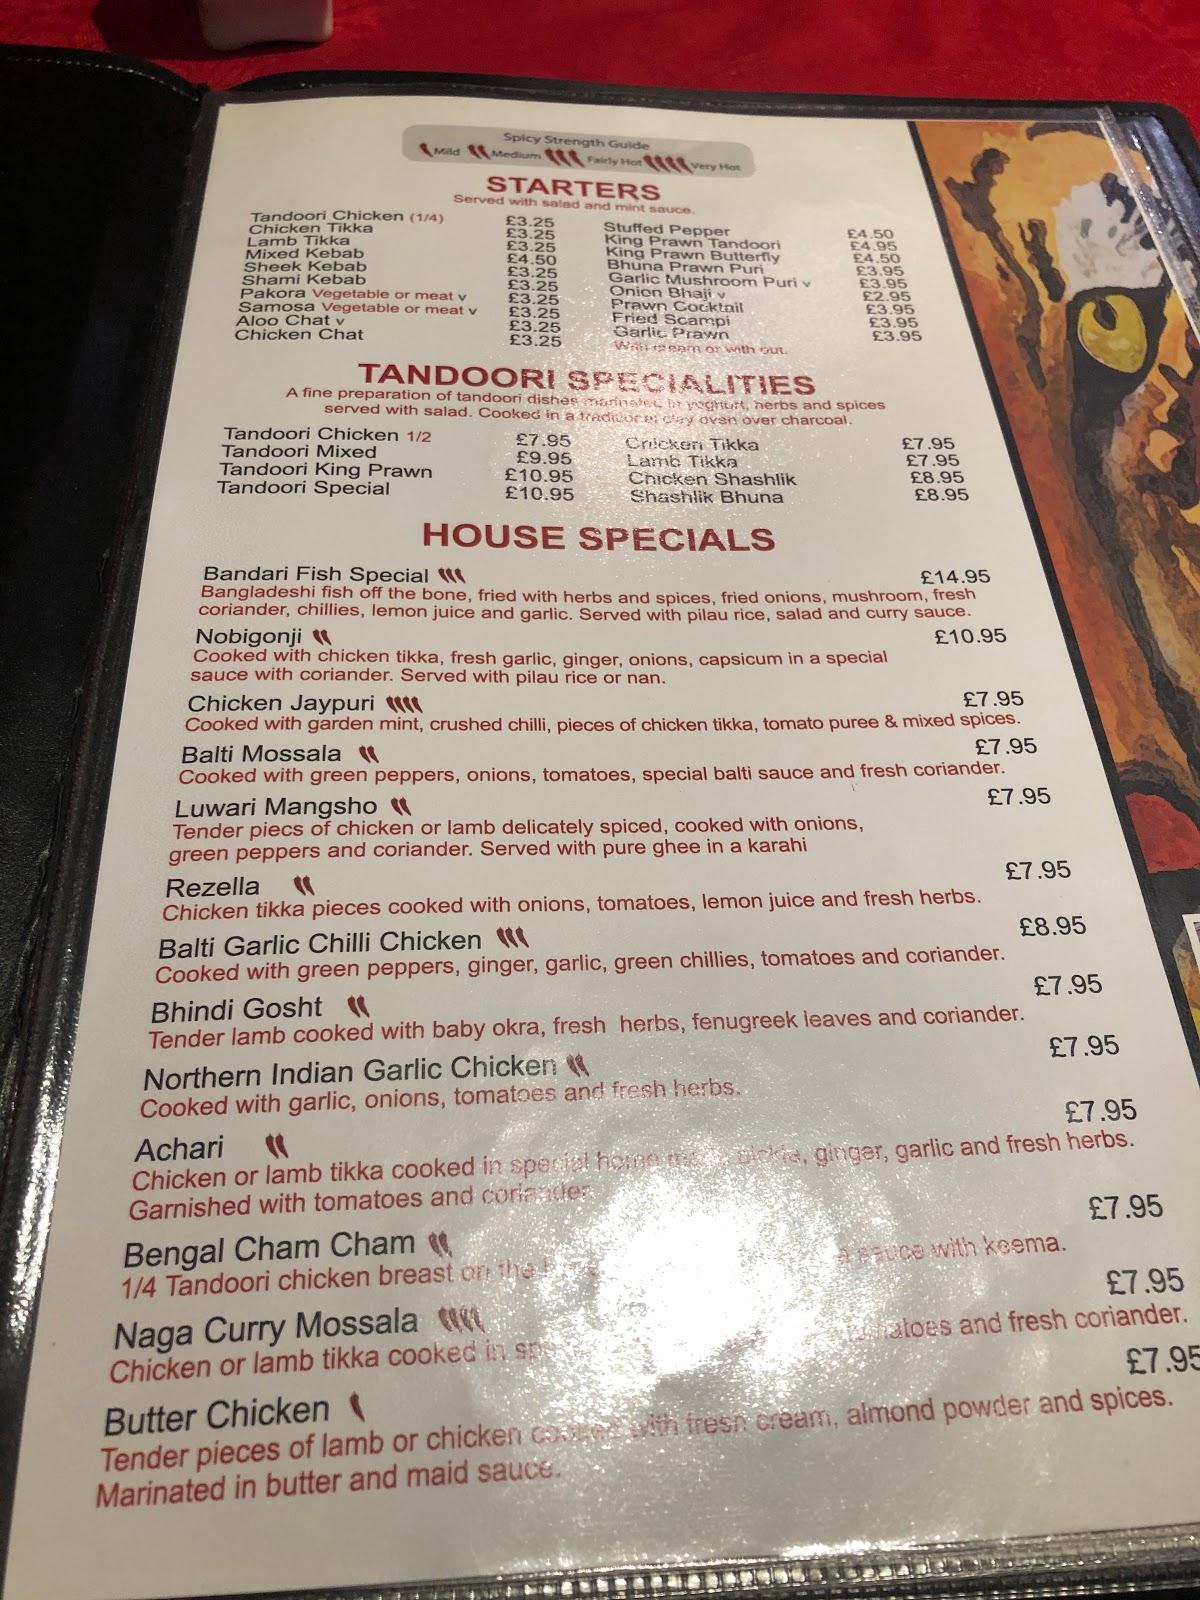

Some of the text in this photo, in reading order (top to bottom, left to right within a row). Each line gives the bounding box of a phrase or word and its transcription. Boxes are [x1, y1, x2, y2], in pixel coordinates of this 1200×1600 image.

[503, 132, 650, 150] Spicy Strength Guide
[433, 146, 461, 157] Mild
[491, 148, 542, 161] Medium
[587, 154, 643, 168] Fairly Hot
[690, 162, 741, 173] Very Hot
[487, 176, 660, 200] STARTERS
[453, 194, 695, 214] Served with salad and mint sauce.
[251, 210, 443, 224] Tandoori Chicken (1/4)
[506, 215, 555, 228] £3.25
[249, 220, 373, 235] Chicken Tikka
[506, 227, 555, 240] £3.25
[604, 221, 730, 239] Stuffed Pepper
[847, 229, 894, 239] £4.50
[247, 233, 350, 247] Lamb Tikka
[507, 240, 556, 253] £3.25
[605, 234, 781, 250] King Prawn Tandoori
[850, 241, 898, 251] £4.95
[246, 246, 364, 260] Mixed Kebab
[507, 253, 557, 266] £4.50
[606, 245, 780, 264] King Prawn Butterfly
[853, 253, 901, 264] £4.50
[244, 261, 367, 273] Sheek Kebab
[508, 266, 558, 279] £3.25
[607, 258, 764, 274] Bhuna Prawn Puri
[856, 265, 904, 277] £3.95
[242, 274, 366, 286] Shami Kebab
[508, 279, 558, 292] £3.25
[859, 278, 908, 289] £3.95
[240, 288, 306, 299] Pakora
[312, 289, 389, 300] Vegetable
[415, 292, 453, 301] meat
[508, 292, 559, 306] £3.25
[863, 291, 911, 302] £2.95
[238, 301, 315, 313] Samosa
[321, 302, 399, 314] Vegetable
[425, 306, 463, 315] meat
[509, 306, 560, 319] £3.25
[866, 304, 915, 315] £3.95
[236, 315, 279, 327] Aloo
[285, 314, 330, 326] Chat
[509, 320, 561, 333] £3.25
[869, 317, 919, 328] £3.95
[235, 328, 363, 341] Chicken Chat
[510, 334, 562, 348] £3.25
[872, 330, 922, 342] £3.95
[358, 363, 815, 395] TANDOORI SPECIALITIES
[224, 427, 431, 443] Tandoori Chicken 1/2
[516, 433, 571, 448] £7.95
[902, 437, 955, 450] £7.95
[222, 444, 376, 459] Tandoori Mixed
[517, 450, 572, 465] £9.95
[906, 454, 960, 467] £7.95
[220, 462, 432, 480] Tandoori King Prawn
[505, 468, 573, 483] £10.95
[629, 471, 797, 486] Chicken Shashlik
[911, 471, 964, 484] £8.95
[217, 480, 389, 497] Tandoori Special
[505, 486, 574, 501] £10.95
[915, 488, 969, 501] £8.95
[630, 489, 784, 504] Shashlik Bhuna
[424, 523, 775, 551] HOUSE SPECIALS
[204, 566, 428, 585] Bandari Fish Special
[921, 569, 990, 584] £14.95
[196, 628, 301, 647] Nobigonji
[935, 628, 1007, 644] £10.95
[188, 695, 374, 718] Chicken Jaypuri
[964, 691, 1024, 707] £7.95
[976, 737, 1037, 755] £7.95
[182, 745, 341, 764] Balti Mossala
[988, 787, 1051, 805] £7.95
[176, 797, 377, 819] Luwari Mangsho
[1006, 860, 1071, 880] £7.95
[166, 877, 259, 898] Rezella
[1020, 916, 1086, 936] £8.95
[159, 931, 481, 959] Balti Garlic Chilli Chicken
[1034, 974, 1102, 996] £7.95
[152, 996, 322, 1023] Bhindi Gosht
[1050, 1034, 1119, 1058] £7.95
[144, 1055, 556, 1090] Northern Indian Garlic Chicken
[1066, 1098, 1137, 1123] £7.95
[134, 1136, 223, 1162] Achari
[1089, 1194, 1163, 1220] £7.95
[124, 1231, 414, 1271] Bengal Cham Cham
[1107, 1267, 1184, 1295] £7.95
[115, 1308, 418, 1354] Naga Curry Mossala
[1127, 1345, 1200, 1375] £7.95
[105, 1397, 329, 1436] Butter Chicken
[96, 1460, 560, 1507] Marinated in butter and maid sauce.
